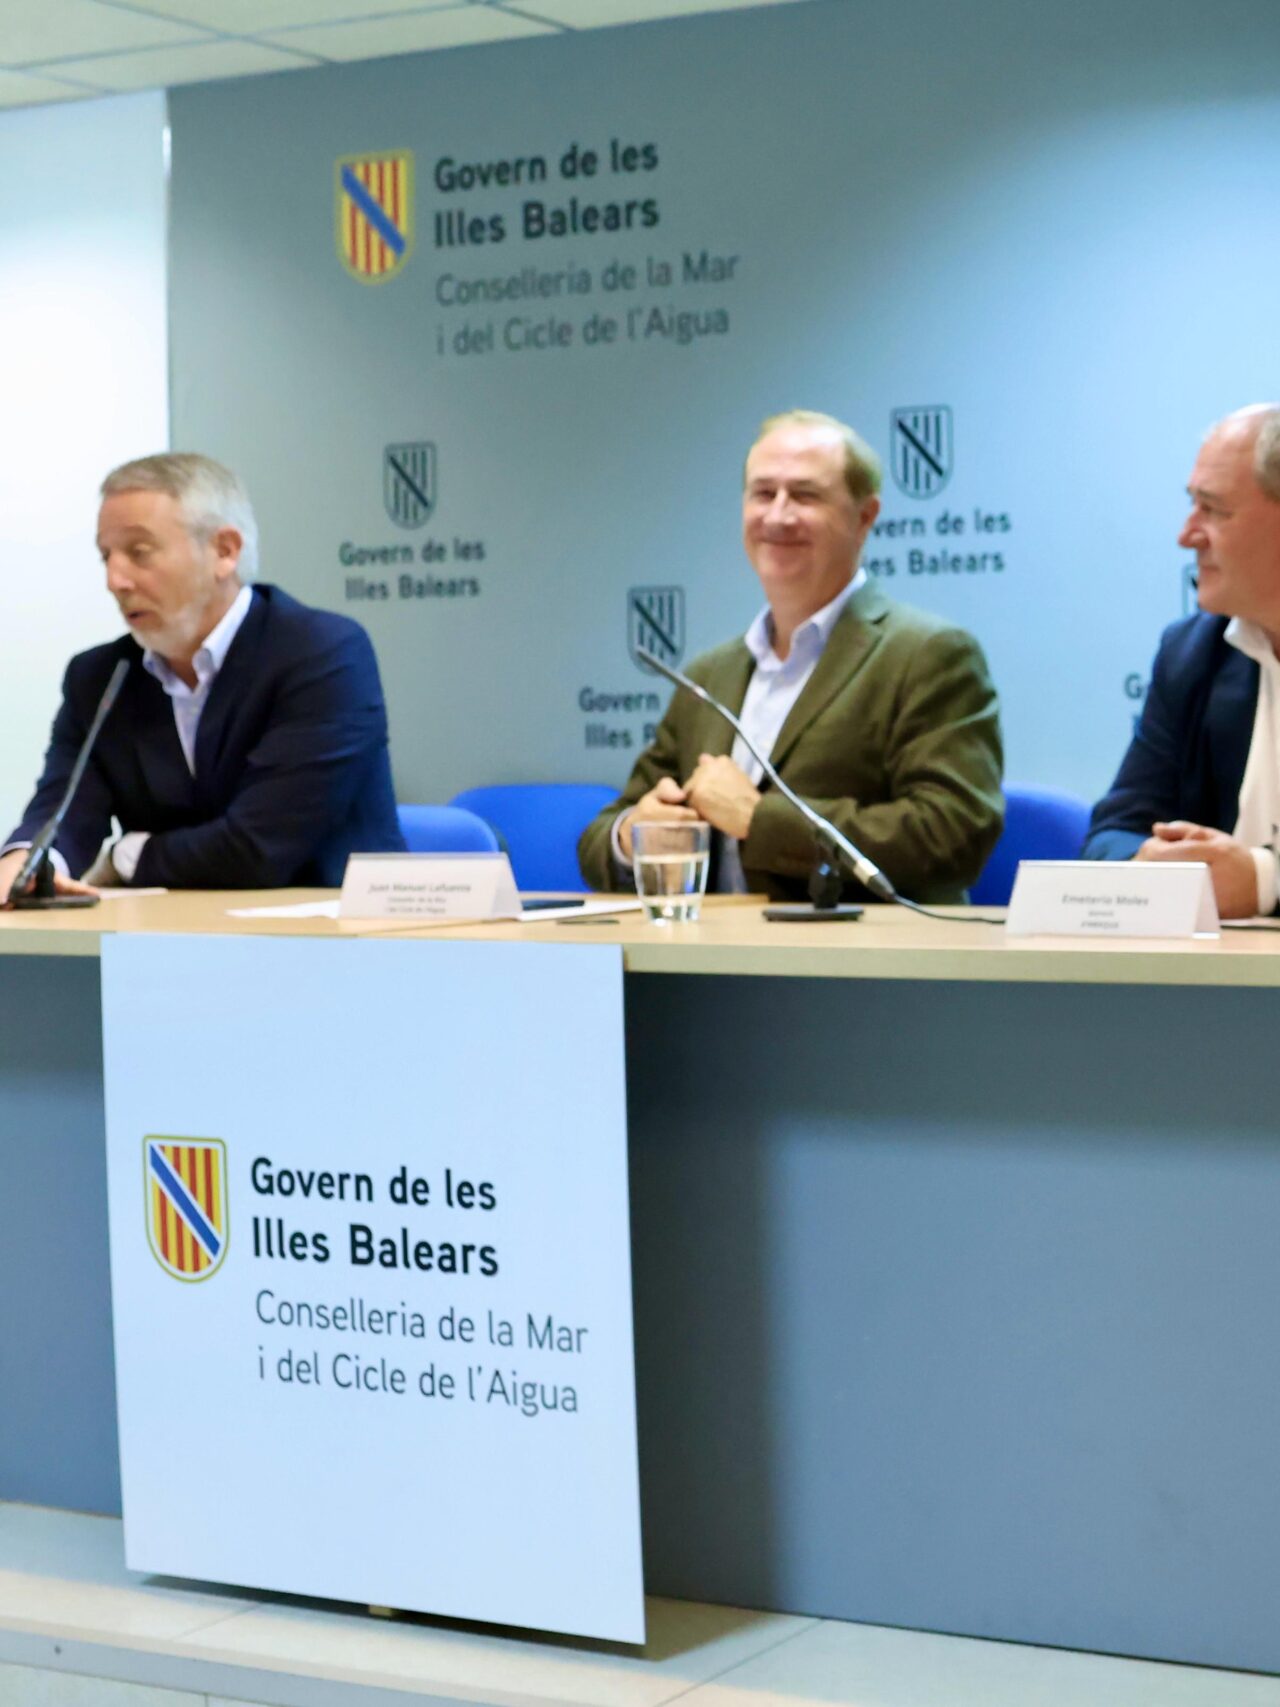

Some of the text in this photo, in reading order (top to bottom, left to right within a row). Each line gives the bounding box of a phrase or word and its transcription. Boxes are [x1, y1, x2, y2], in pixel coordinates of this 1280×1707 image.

[434, 138, 659, 193] Govern de les
[434, 197, 660, 249] Illes Balears
[435, 250, 740, 307] Conselleria de la Mar
[435, 304, 731, 357] i del Cicle de l'Aigua
[935, 507, 966, 536] de
[974, 505, 1012, 536] les
[338, 537, 486, 567] Govern de les
[907, 546, 1006, 577] Balears
[345, 574, 482, 601] Illes Balears
[578, 685, 660, 713] Govern
[584, 722, 633, 751] Illes
[250, 1156, 498, 1211] Govern de les
[252, 1216, 499, 1277] Illes Balears
[255, 1289, 589, 1354] Conselleria de la Mar
[258, 1346, 578, 1418] i del Cicle de l'Aigua
